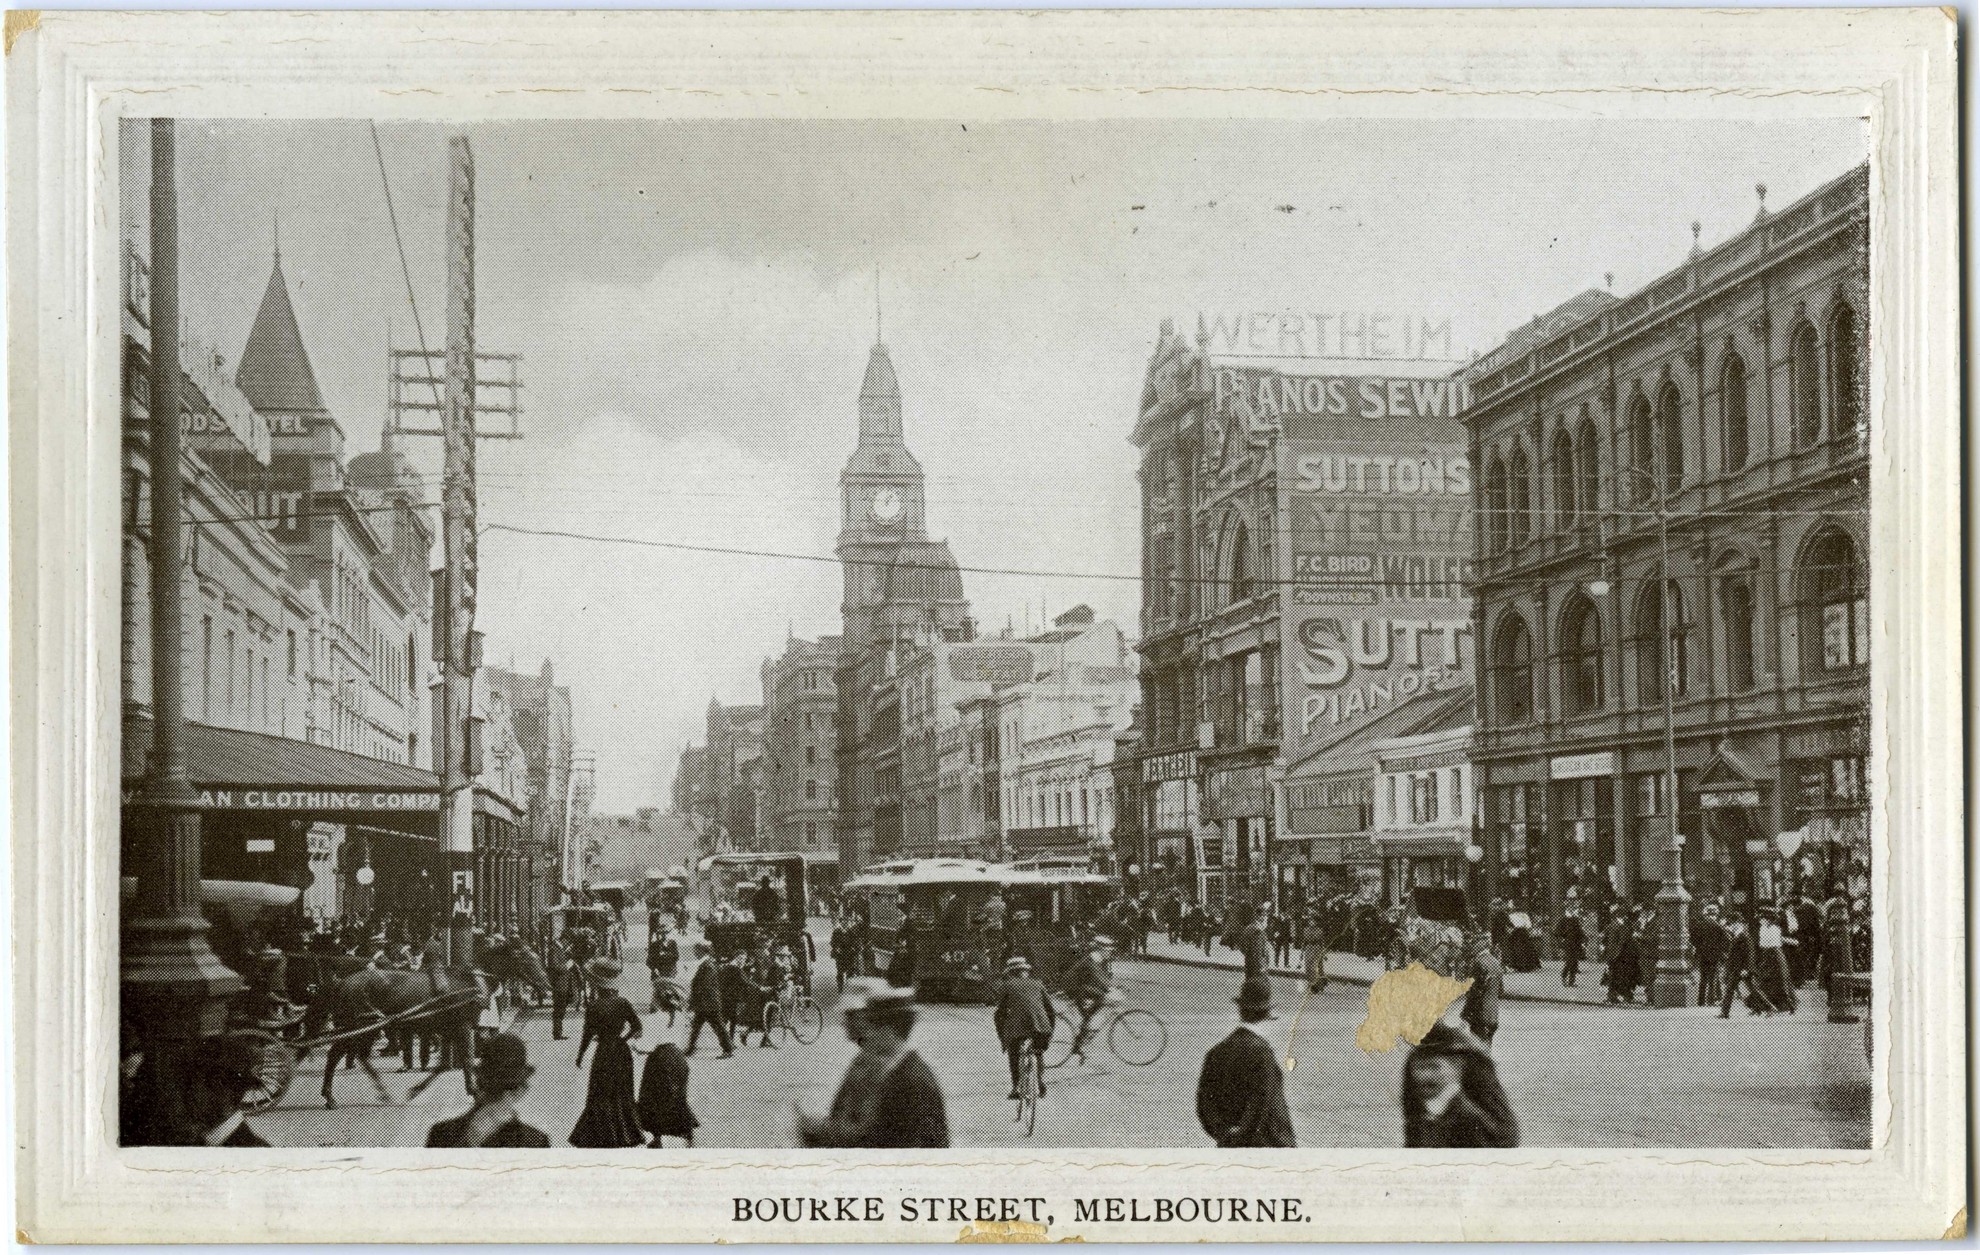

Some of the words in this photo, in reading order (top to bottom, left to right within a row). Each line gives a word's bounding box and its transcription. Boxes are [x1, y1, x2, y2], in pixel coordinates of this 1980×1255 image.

[1208, 311, 1451, 359] WERTHEIM
[1212, 370, 1346, 415] PANOS
[1296, 455, 1470, 494] SUTTONS
[1295, 617, 1473, 689] SUTT
[245, 791, 361, 808] CLOTHING
